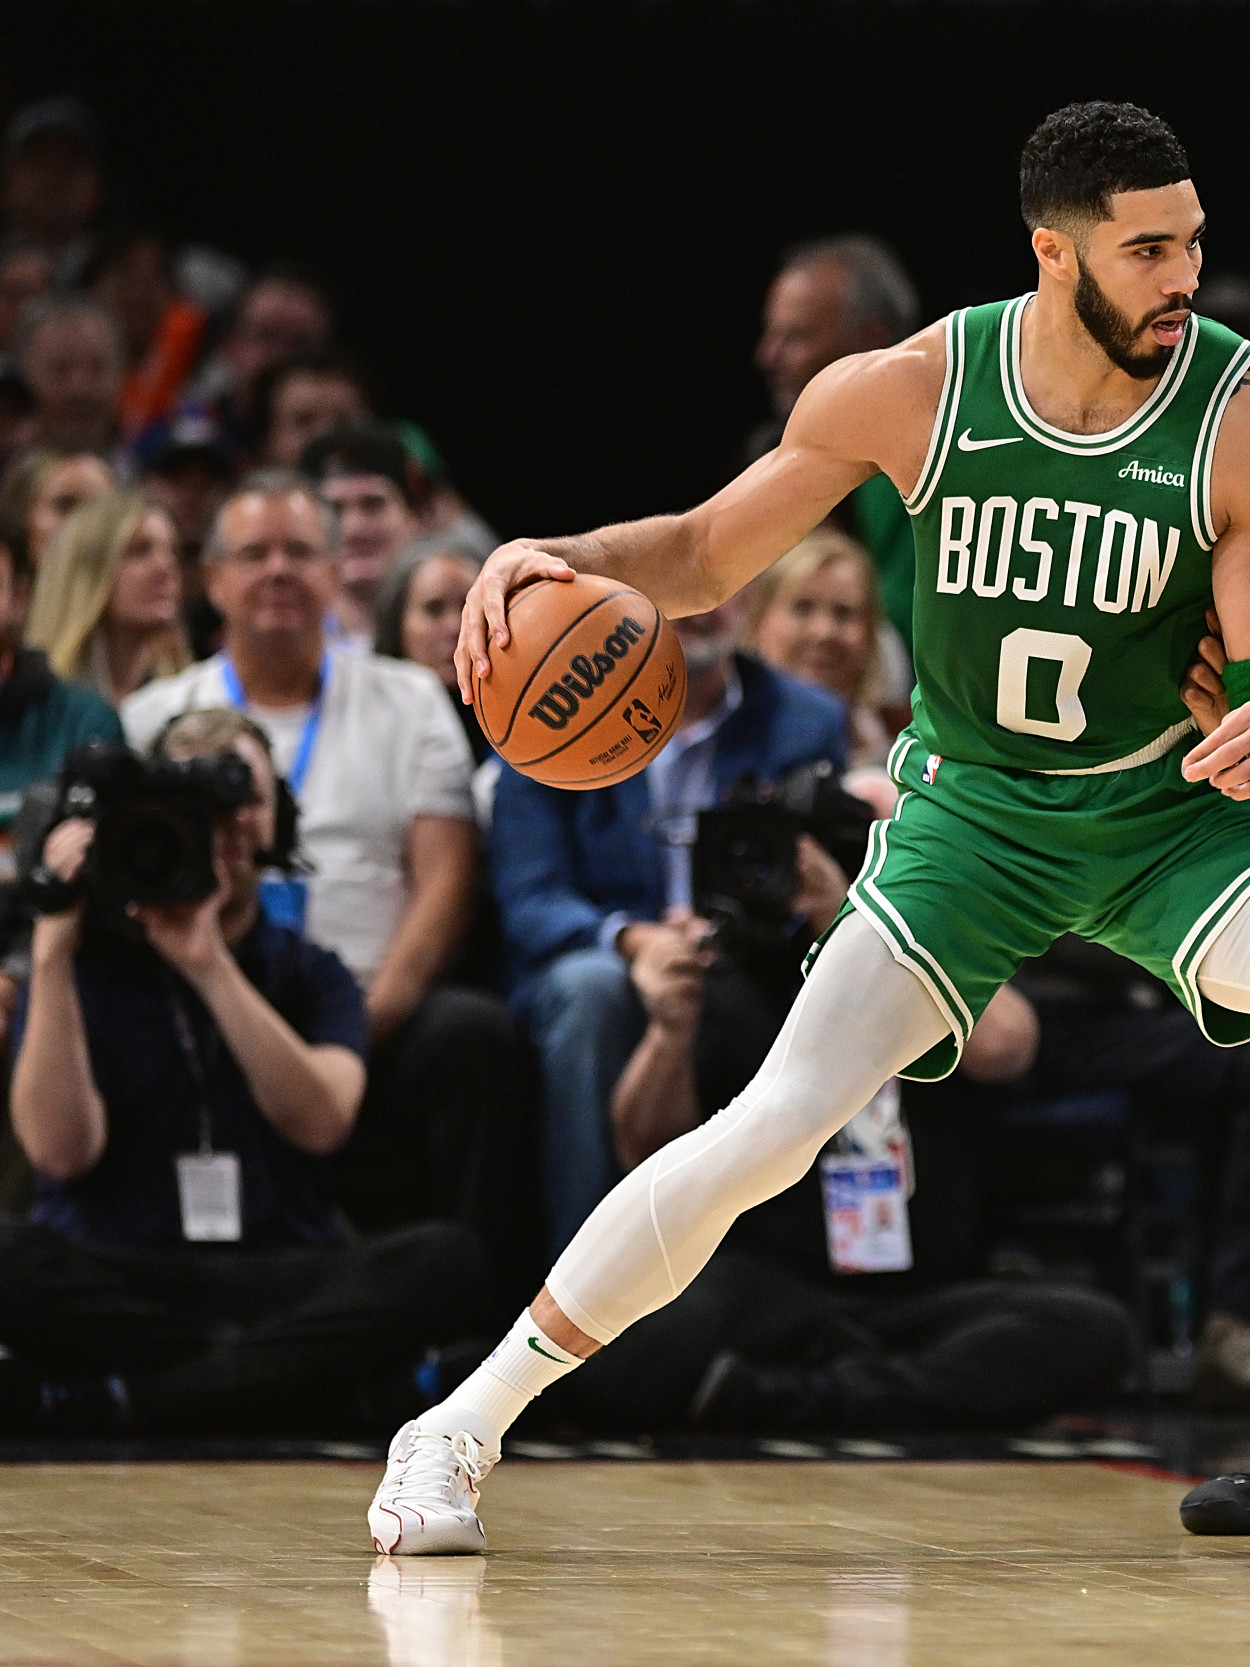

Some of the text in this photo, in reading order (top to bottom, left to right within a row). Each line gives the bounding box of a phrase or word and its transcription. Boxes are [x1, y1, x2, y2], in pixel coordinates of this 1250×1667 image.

[1118, 460, 1185, 488] Amica
[936, 496, 1181, 614] BOSTON
[528, 616, 646, 730] Wilson
[997, 627, 1093, 742] 0
